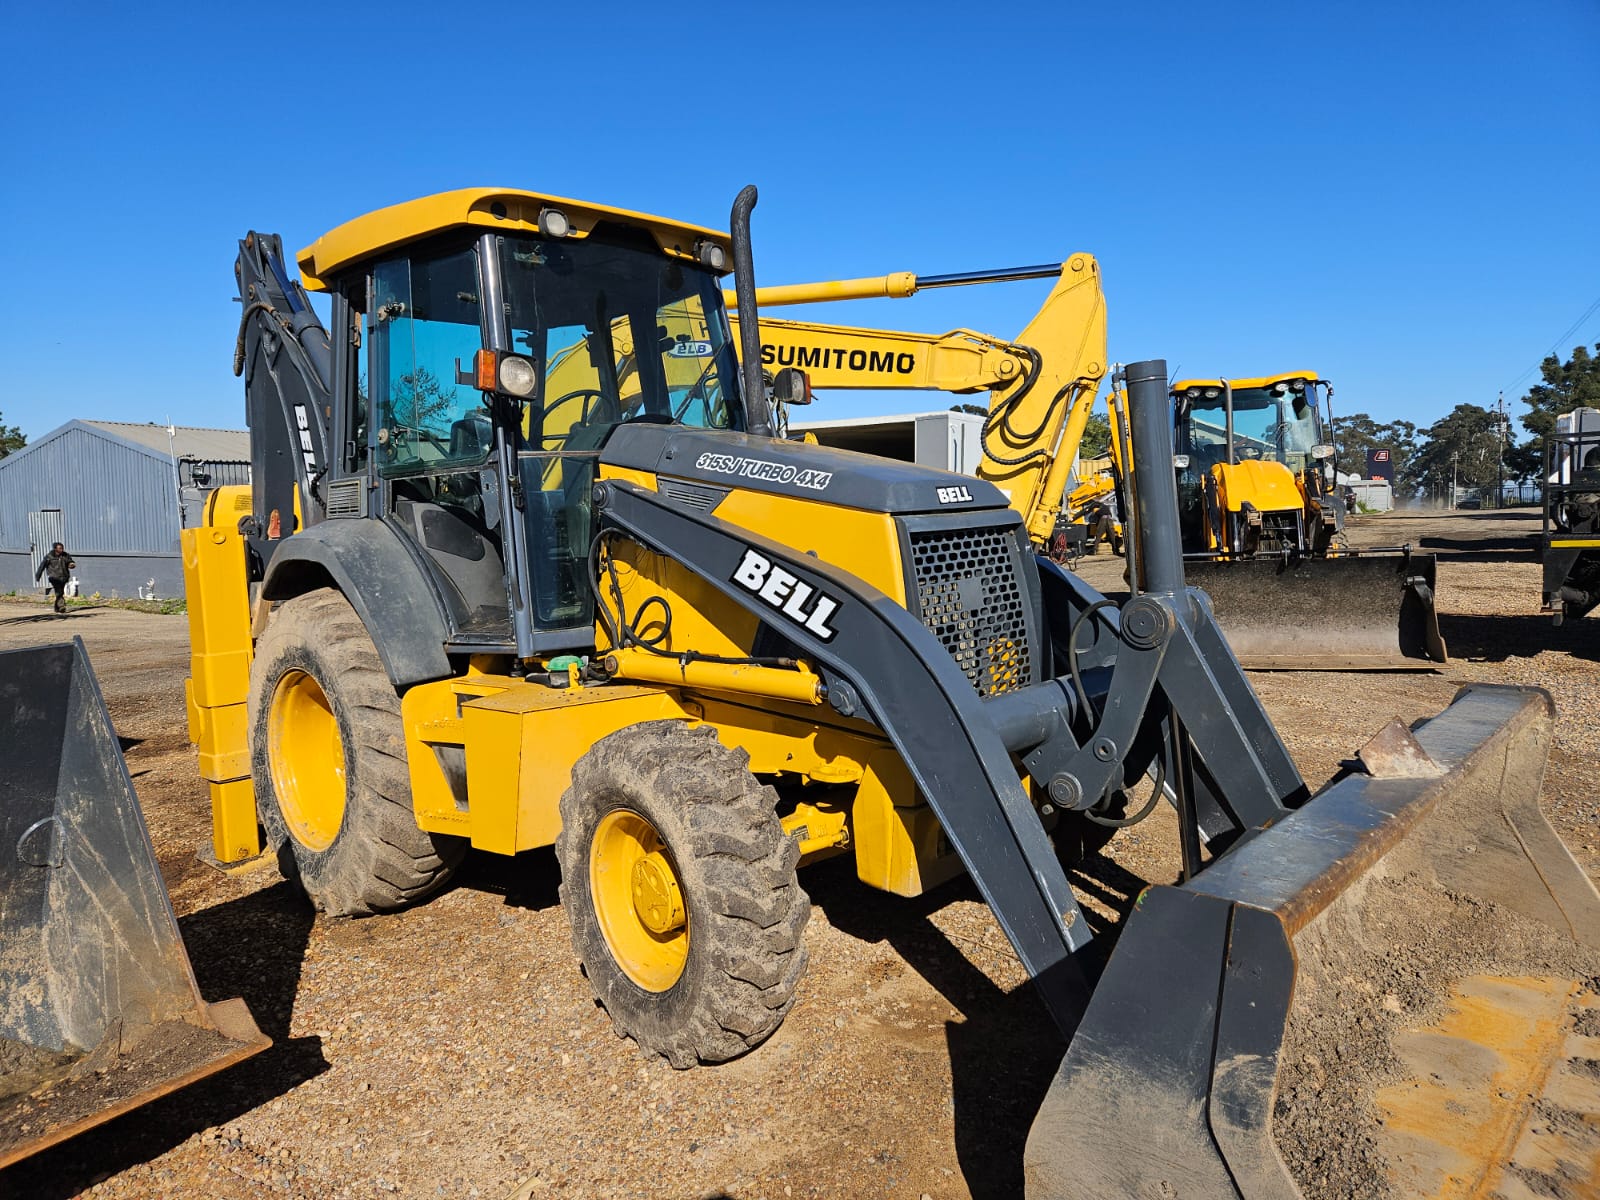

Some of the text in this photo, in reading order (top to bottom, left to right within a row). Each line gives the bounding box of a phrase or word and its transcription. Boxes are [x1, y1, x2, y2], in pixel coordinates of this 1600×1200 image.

[761, 344, 915, 374] SUMITOMO
[696, 453, 833, 490] 315SJ TURBO 4X4
[936, 485, 973, 504] BELL
[731, 548, 838, 640] BELL
